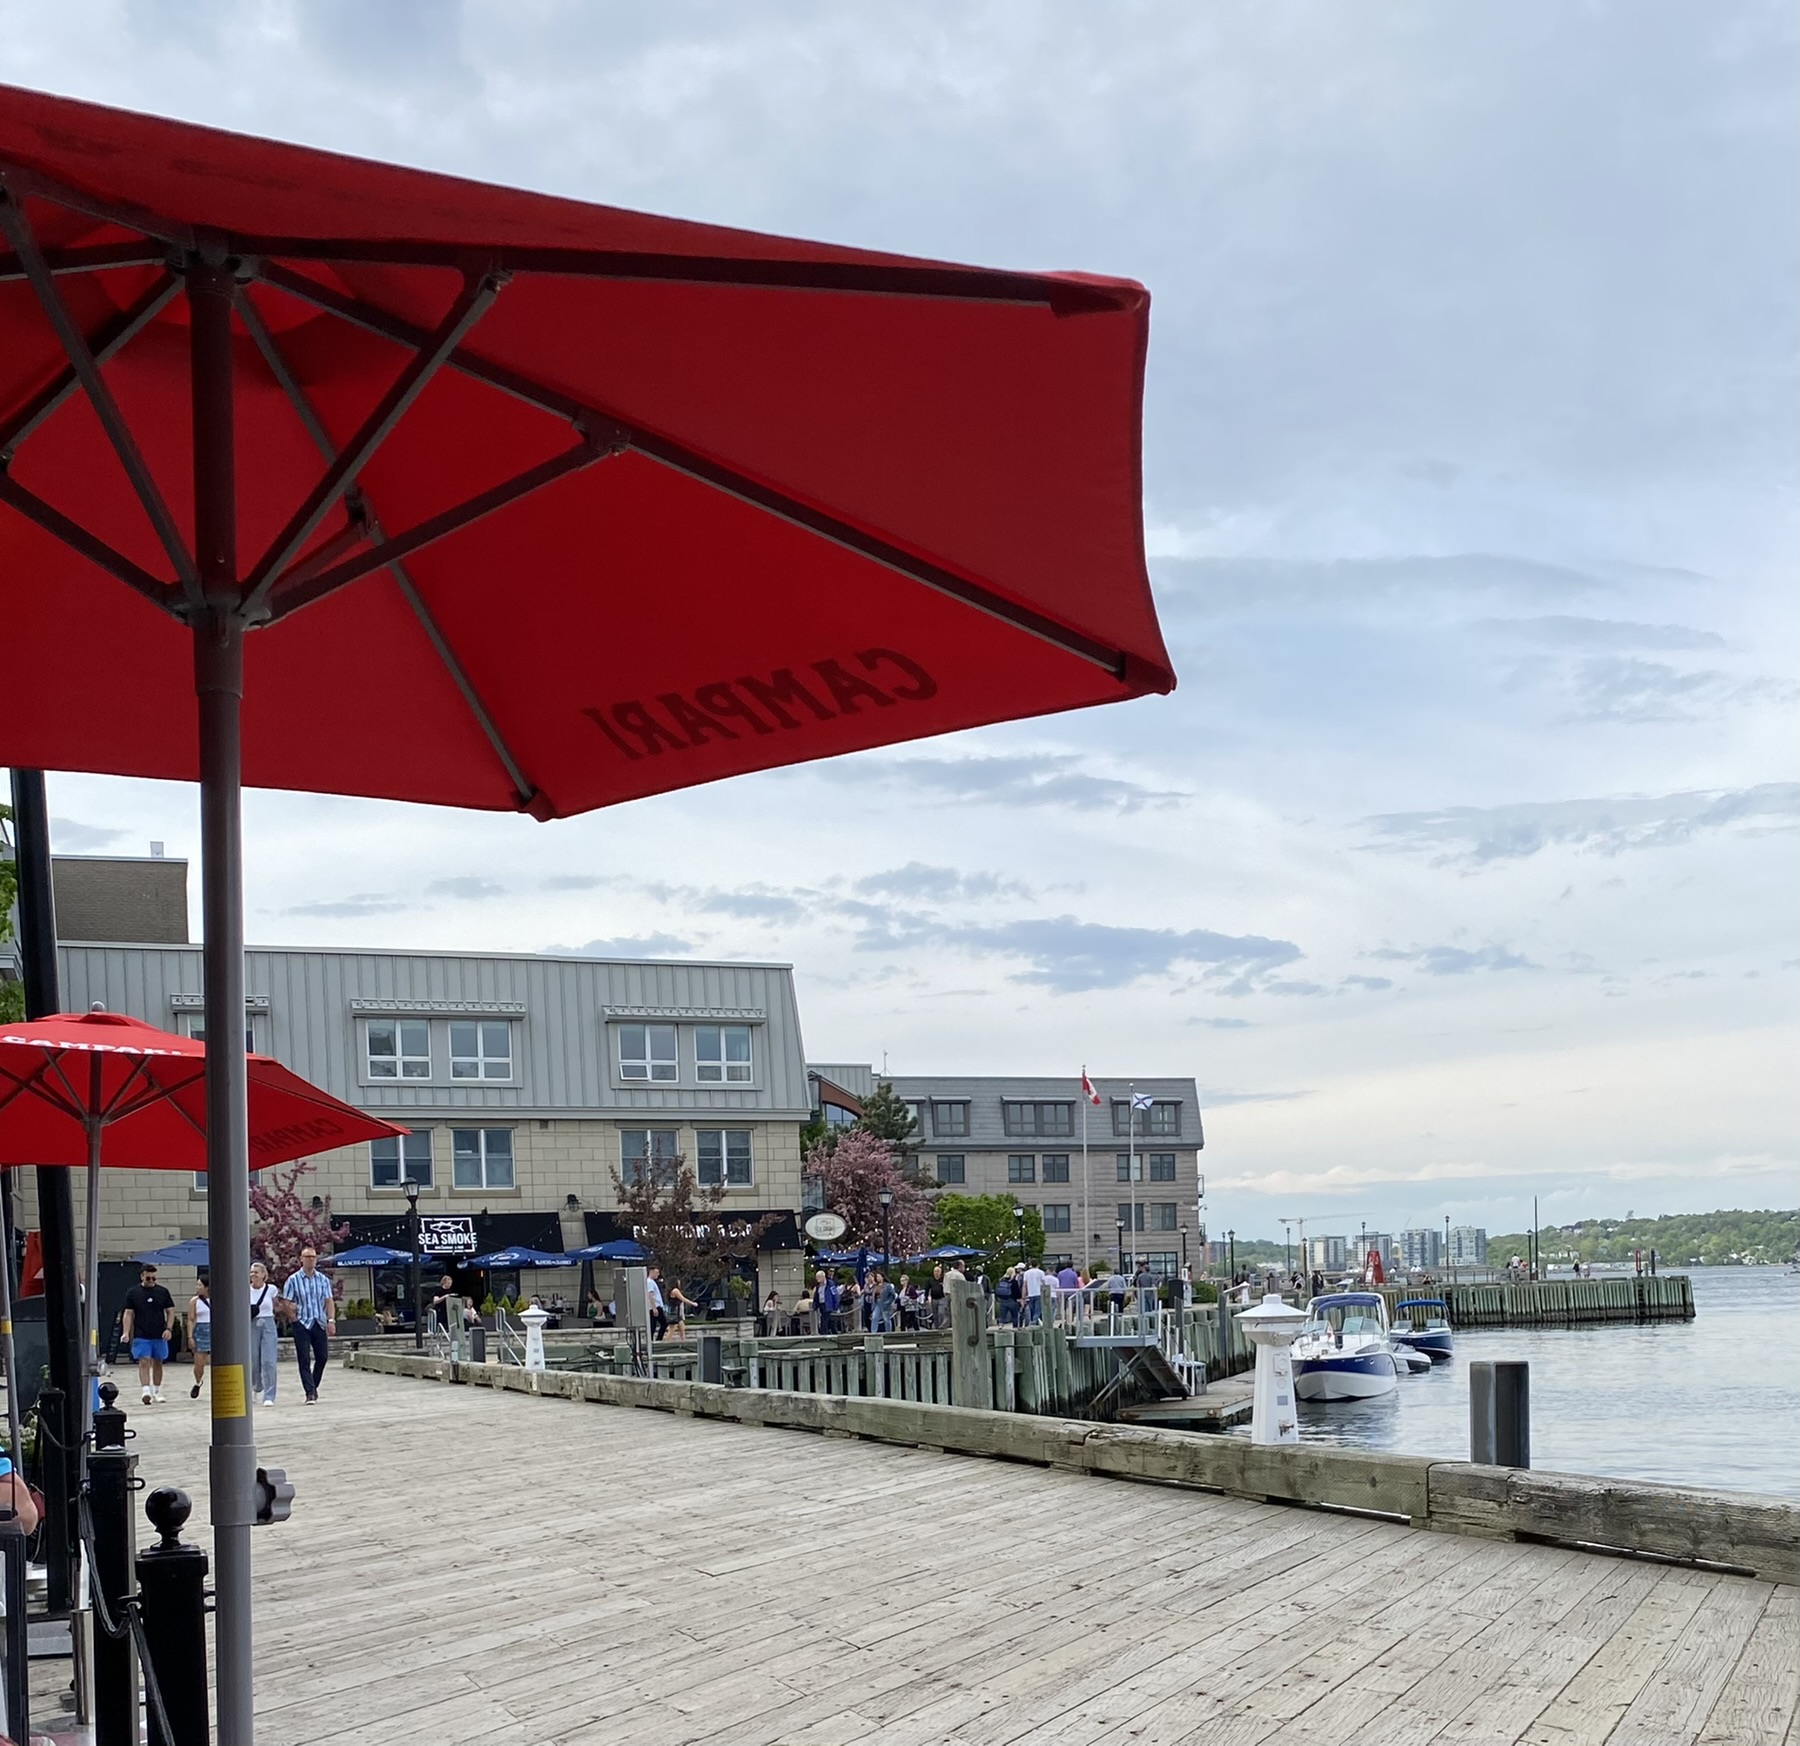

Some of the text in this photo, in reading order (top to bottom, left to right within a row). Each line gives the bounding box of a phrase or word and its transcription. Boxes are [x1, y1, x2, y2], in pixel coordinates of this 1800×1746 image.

[2, 1035, 182, 1056] CAMPAR
[418, 1232, 478, 1245] SEA SMOKE
